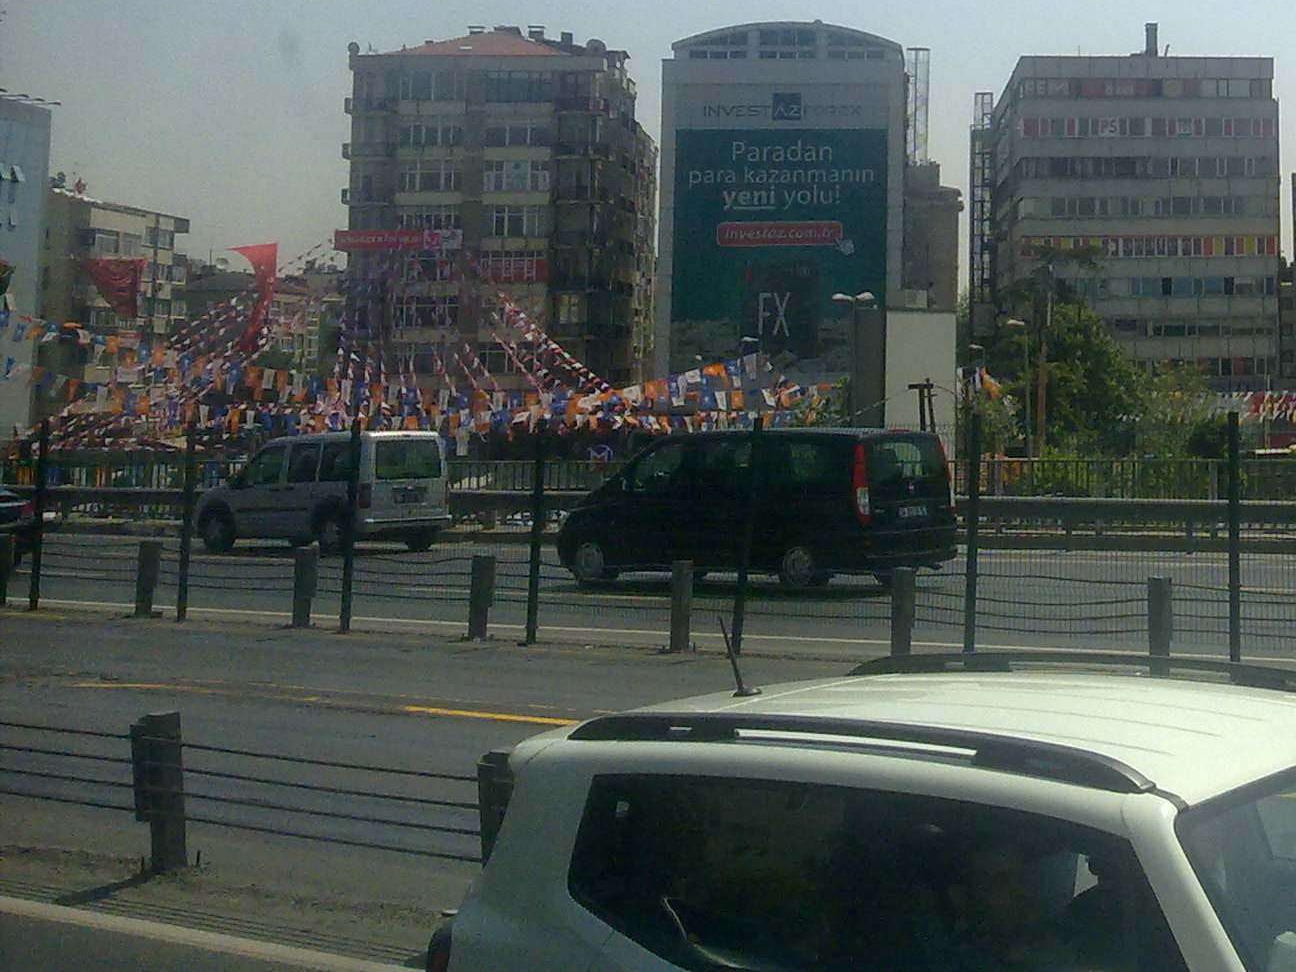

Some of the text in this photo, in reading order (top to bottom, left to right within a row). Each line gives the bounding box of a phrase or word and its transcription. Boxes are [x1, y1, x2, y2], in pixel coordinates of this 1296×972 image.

[731, 140, 833, 162] Paradan
[689, 169, 736, 189] para
[723, 184, 841, 210] yeni yolu!
[757, 291, 792, 338] FX
